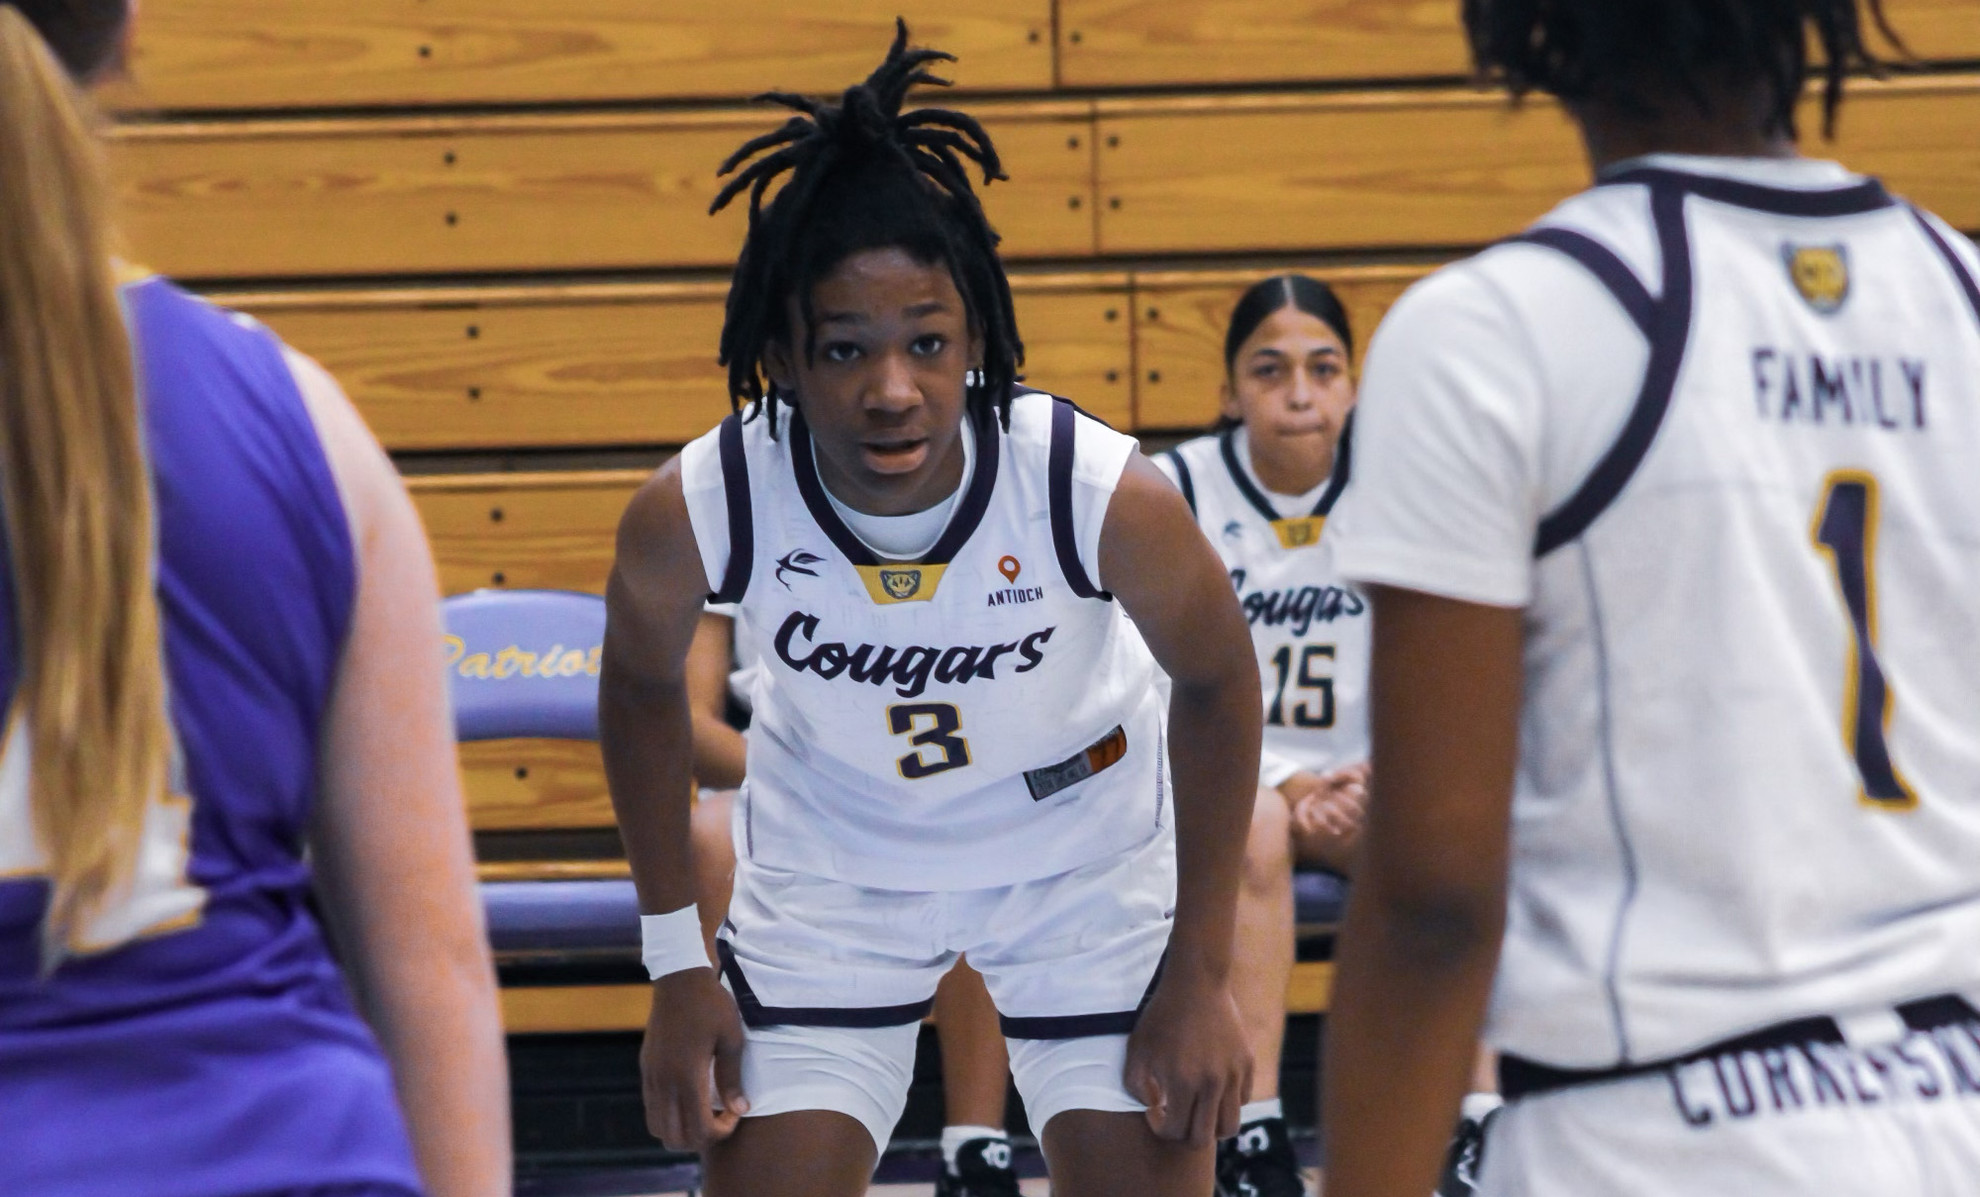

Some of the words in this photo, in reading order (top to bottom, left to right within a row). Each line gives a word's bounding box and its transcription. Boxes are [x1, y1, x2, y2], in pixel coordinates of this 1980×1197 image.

[1752, 348, 1926, 430] FAMILY
[987, 586, 1044, 607] ANTIOCH
[774, 610, 1056, 698] Cougars
[1811, 469, 1919, 810] 1
[1267, 642, 1336, 729] 15
[886, 702, 972, 780] 3
